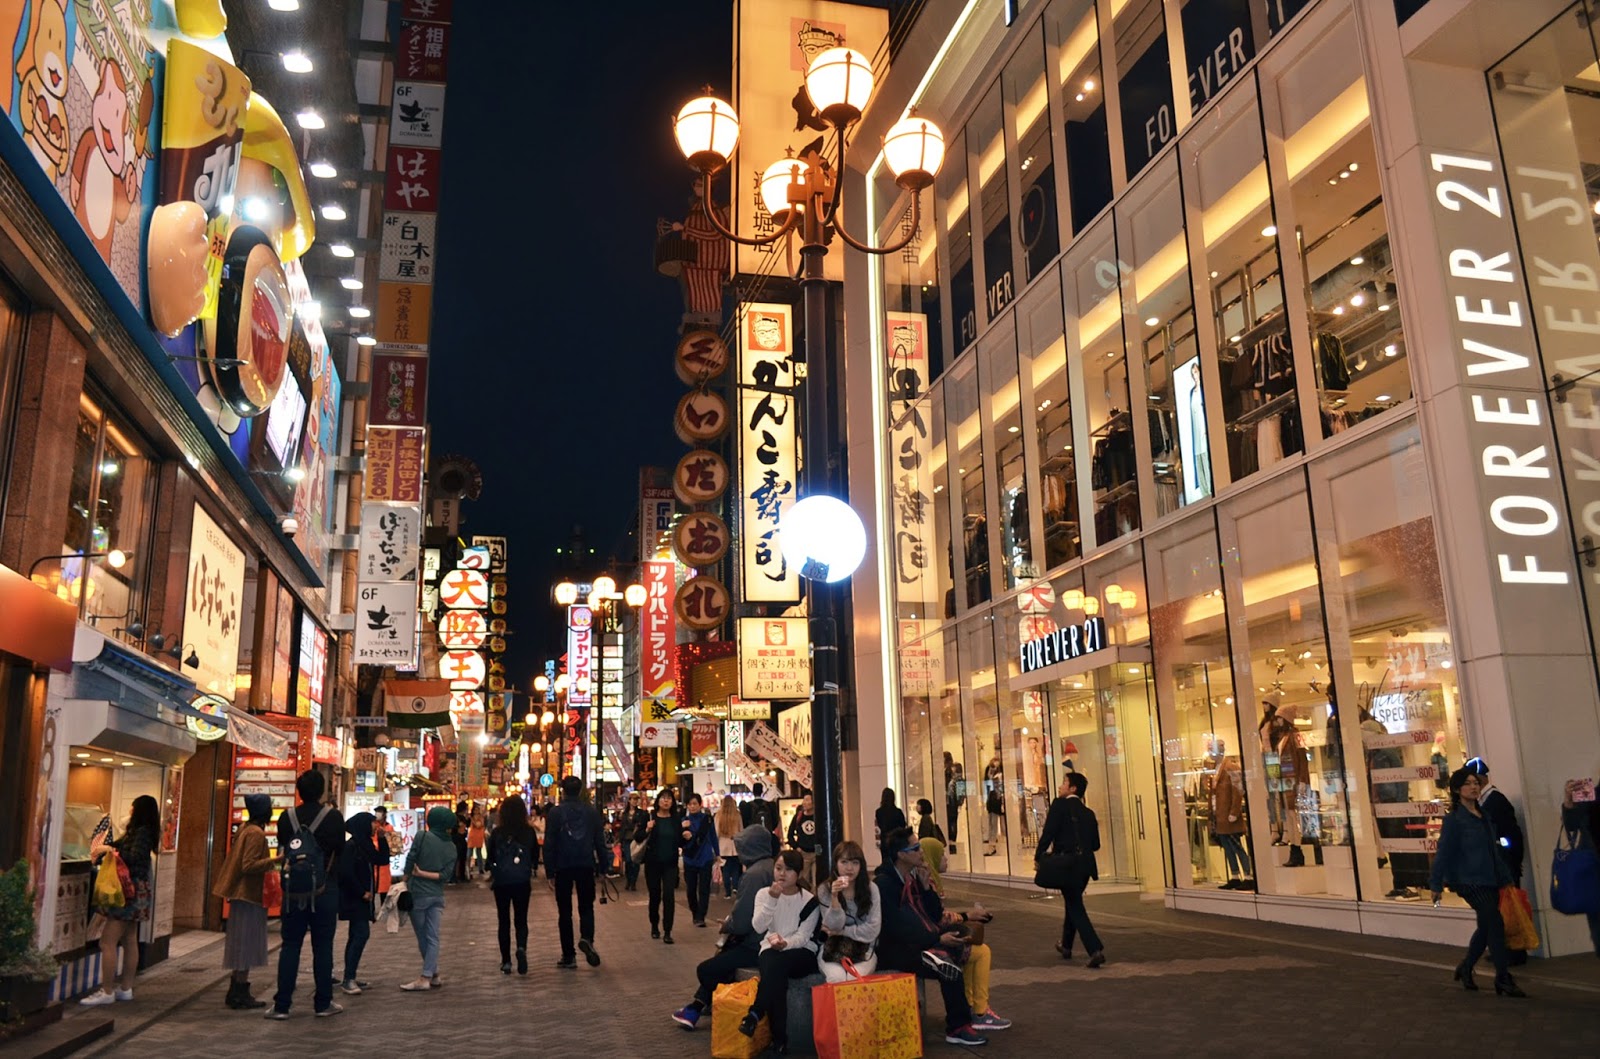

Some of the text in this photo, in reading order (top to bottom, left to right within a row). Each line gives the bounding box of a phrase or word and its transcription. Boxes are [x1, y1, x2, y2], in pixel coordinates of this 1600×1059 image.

[408, 24, 424, 76] ダイニング
[424, 27, 444, 58] 相席
[397, 86, 412, 97] 6F
[1145, 27, 1247, 157] FOEVER
[396, 151, 430, 208] はや
[1430, 153, 1502, 218] 21
[385, 216, 399, 226] 4F
[397, 221, 430, 278] 白木屋
[406, 430, 421, 438] 2F
[1448, 248, 1569, 586] FOREVER
[645, 487, 673, 499] 3F/4F
[361, 587, 378, 600] 6F
[648, 564, 669, 680] ツルハドラッグ
[1019, 618, 1101, 674] FOREVER 21
[1358, 668, 1428, 719] Winter
[1378, 702, 1429, 724] SPECIALS
